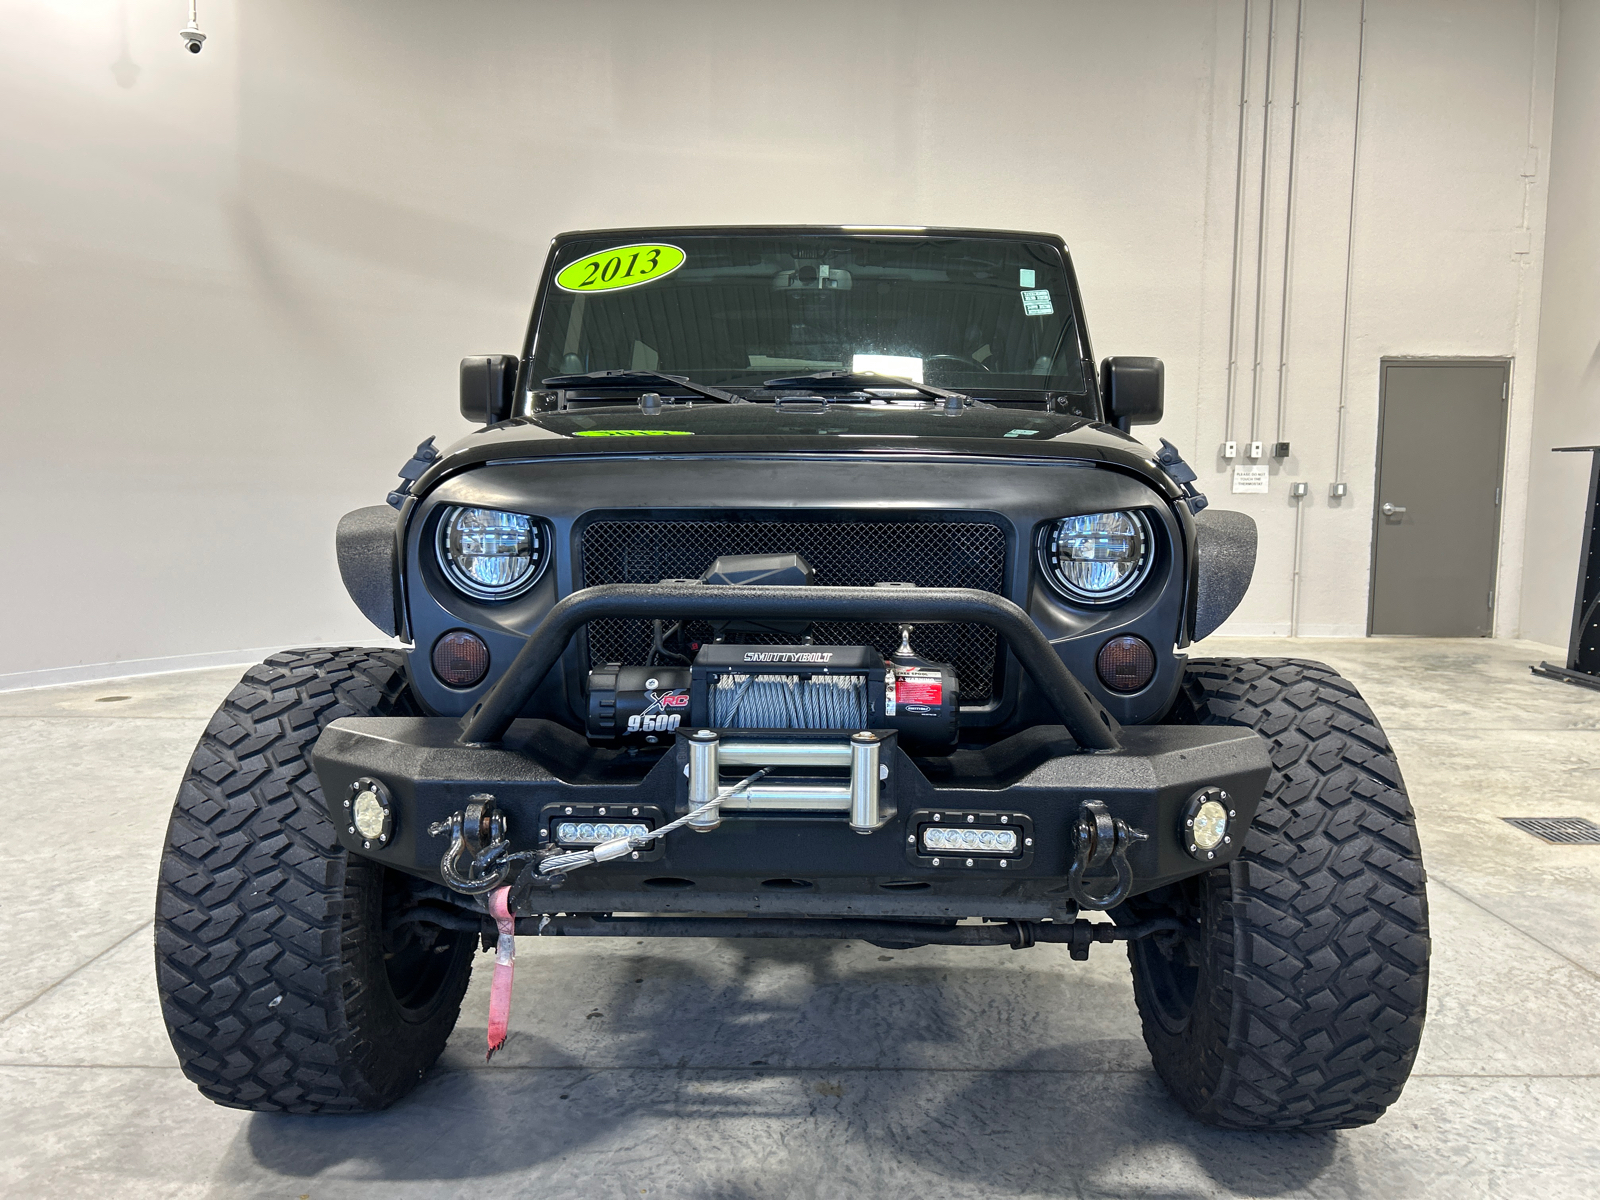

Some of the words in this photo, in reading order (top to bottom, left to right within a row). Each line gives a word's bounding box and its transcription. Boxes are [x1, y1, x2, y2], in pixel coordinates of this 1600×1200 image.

[578, 248, 661, 288] 2013
[743, 652, 833, 662] SMITTYBILT
[640, 690, 690, 718] XRC
